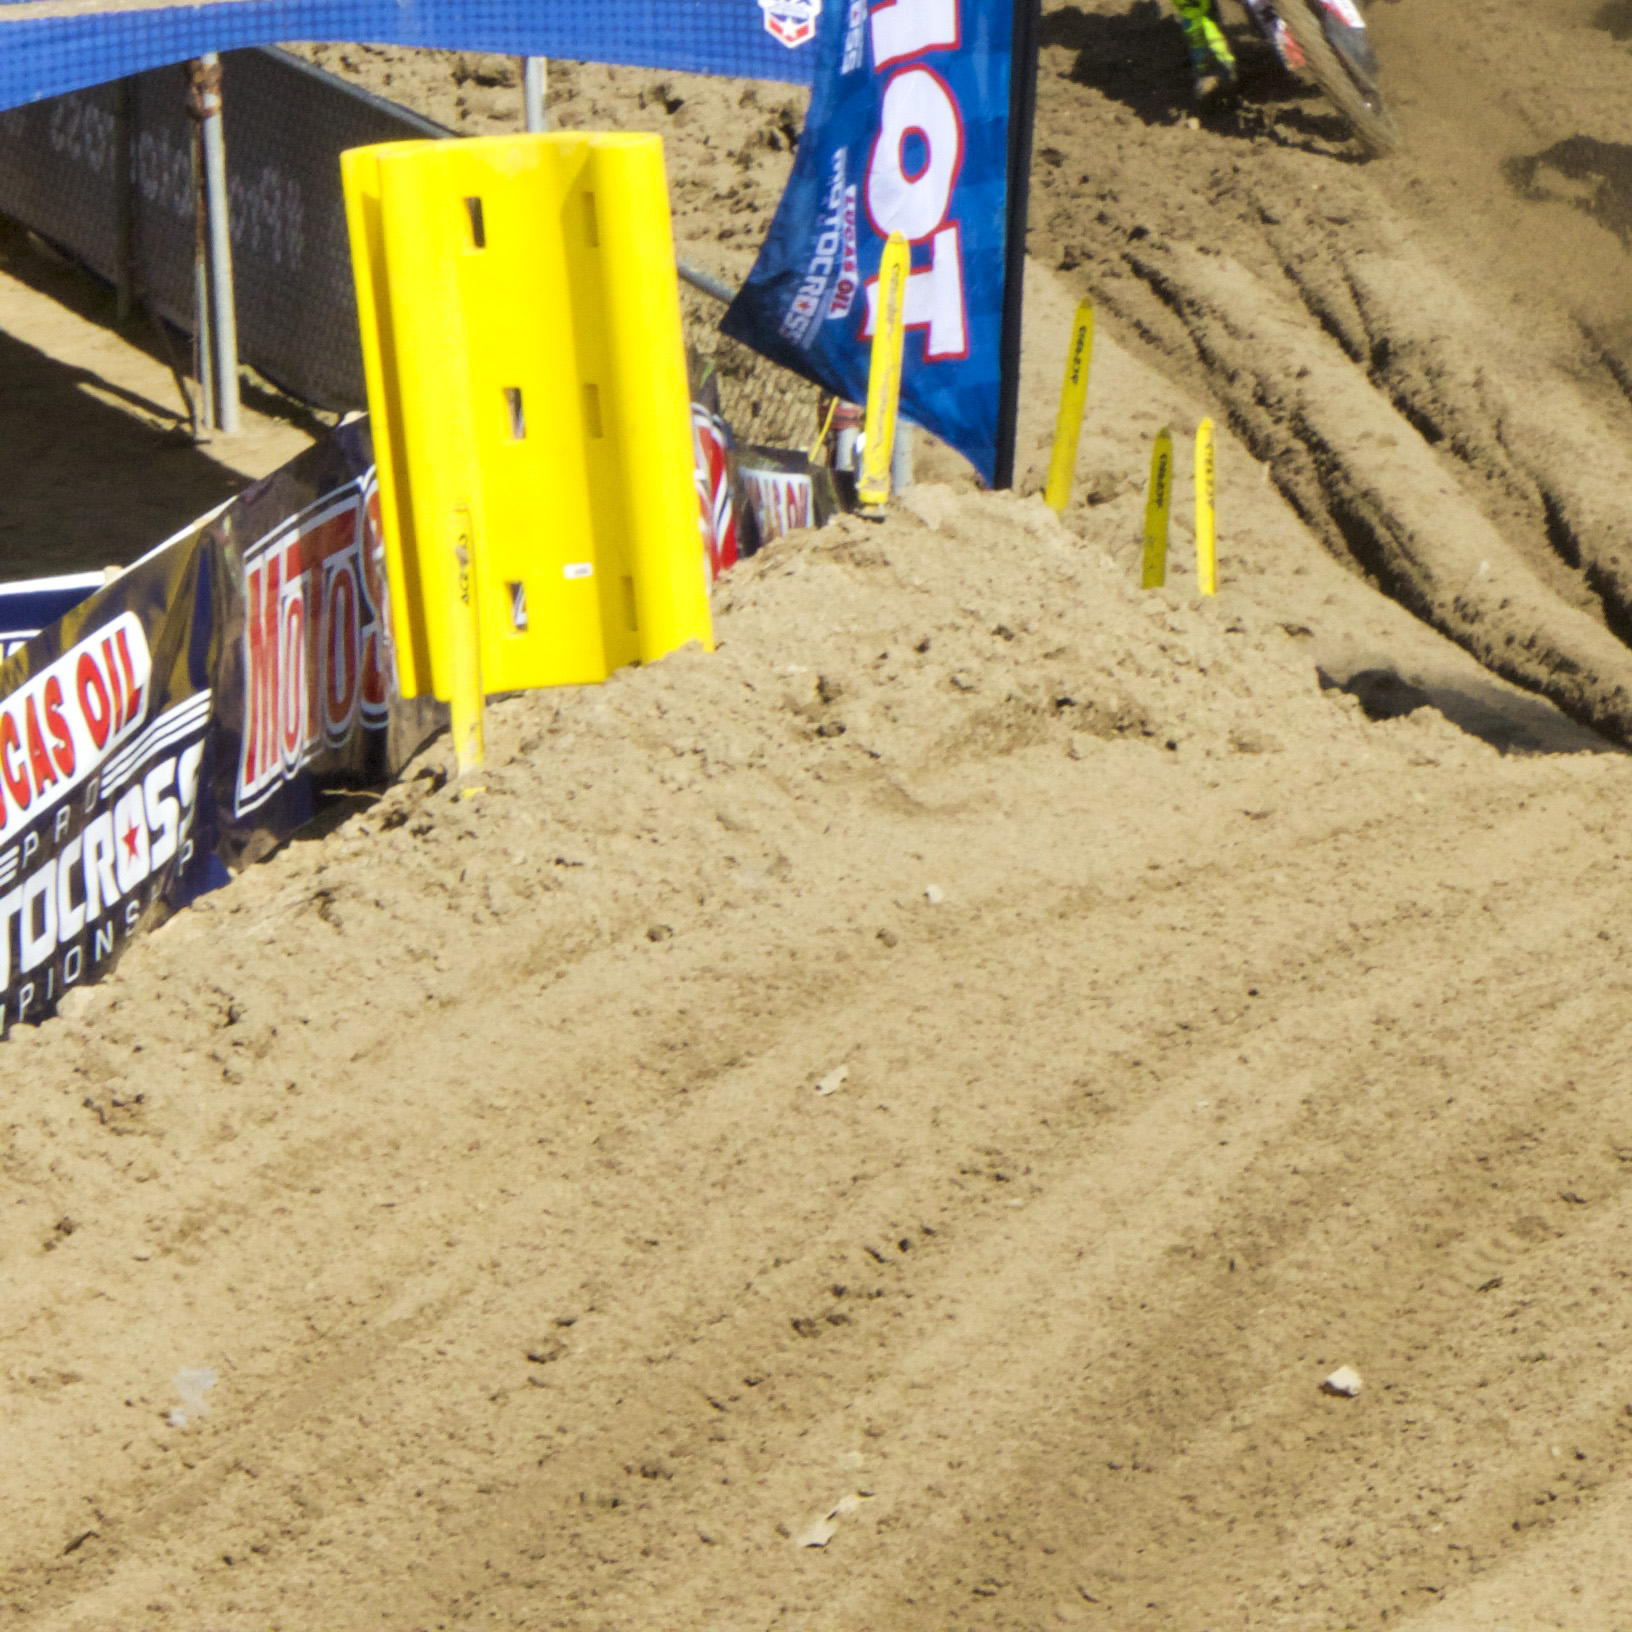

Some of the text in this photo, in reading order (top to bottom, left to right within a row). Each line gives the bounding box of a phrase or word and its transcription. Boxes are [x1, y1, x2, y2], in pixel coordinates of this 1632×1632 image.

[0, 627, 142, 830] CAS OIL
[23, 777, 99, 867] PRO
